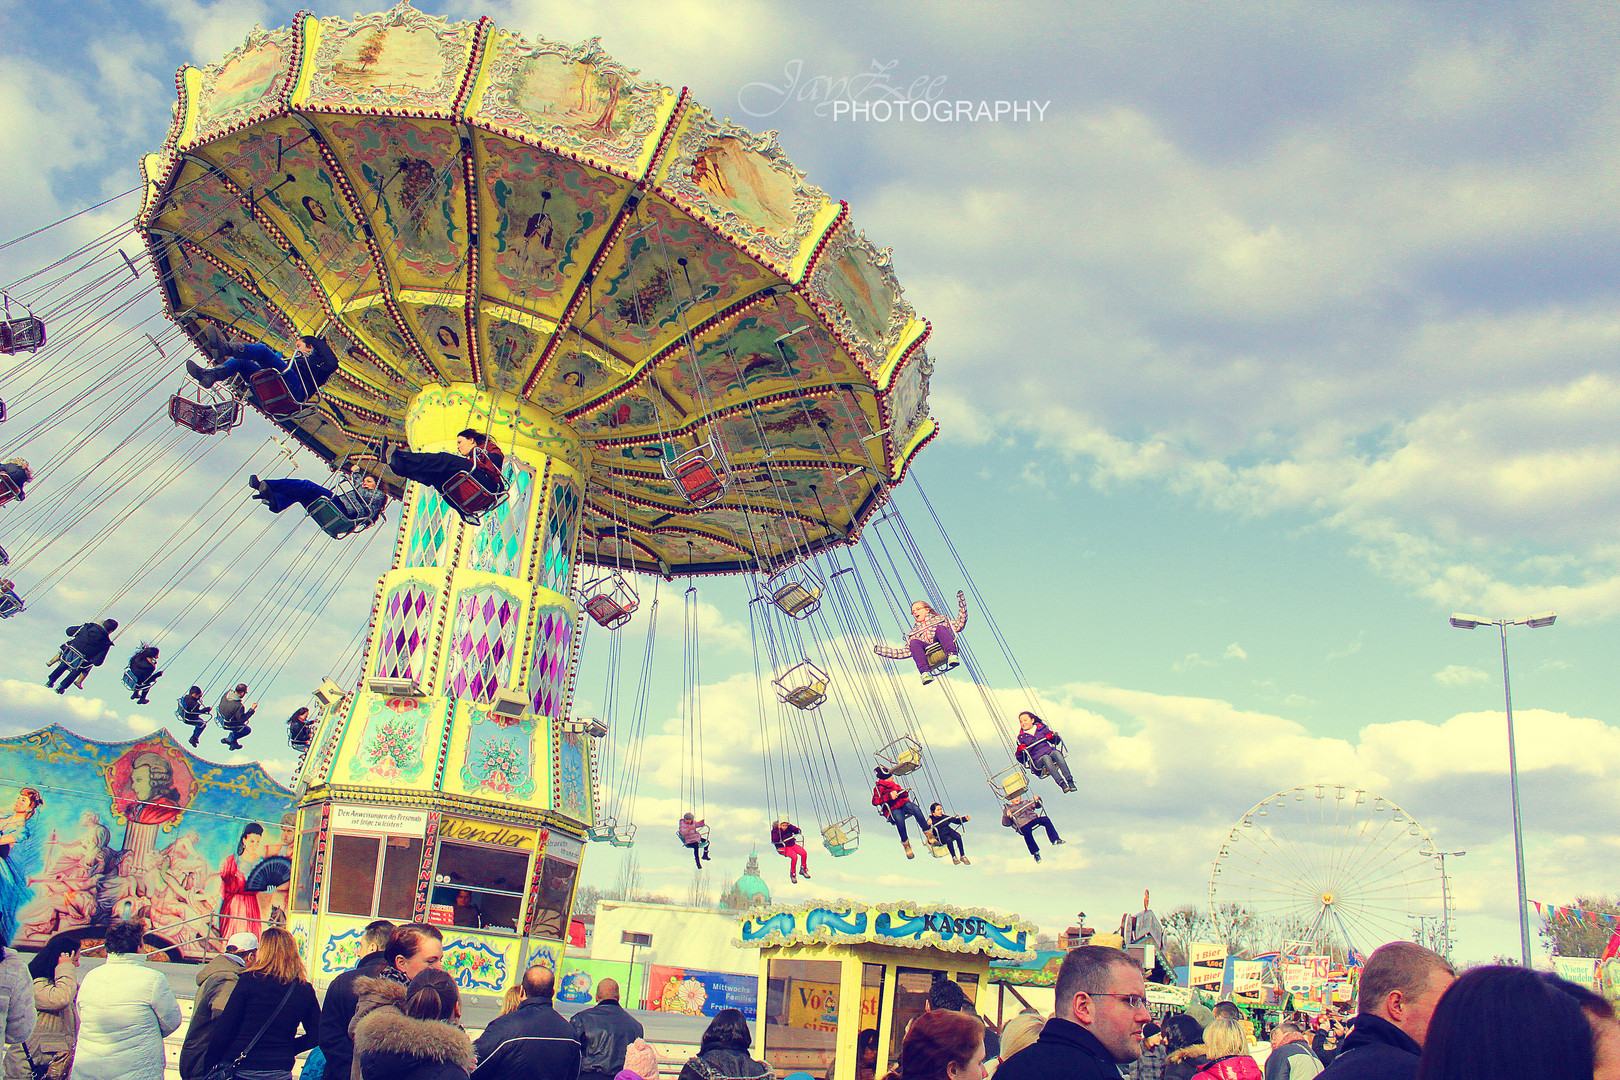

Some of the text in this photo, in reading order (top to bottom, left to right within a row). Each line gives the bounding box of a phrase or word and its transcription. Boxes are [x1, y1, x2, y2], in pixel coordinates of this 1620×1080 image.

[440, 819, 531, 847] Wendler
[415, 811, 440, 922] WELLENFLUG
[923, 914, 987, 936] KASSE
[1202, 949, 1221, 959] Bier
[1562, 964, 1588, 973] Wiener
[1204, 972, 1221, 982] Bier
[713, 983, 750, 993] Mittwochs
